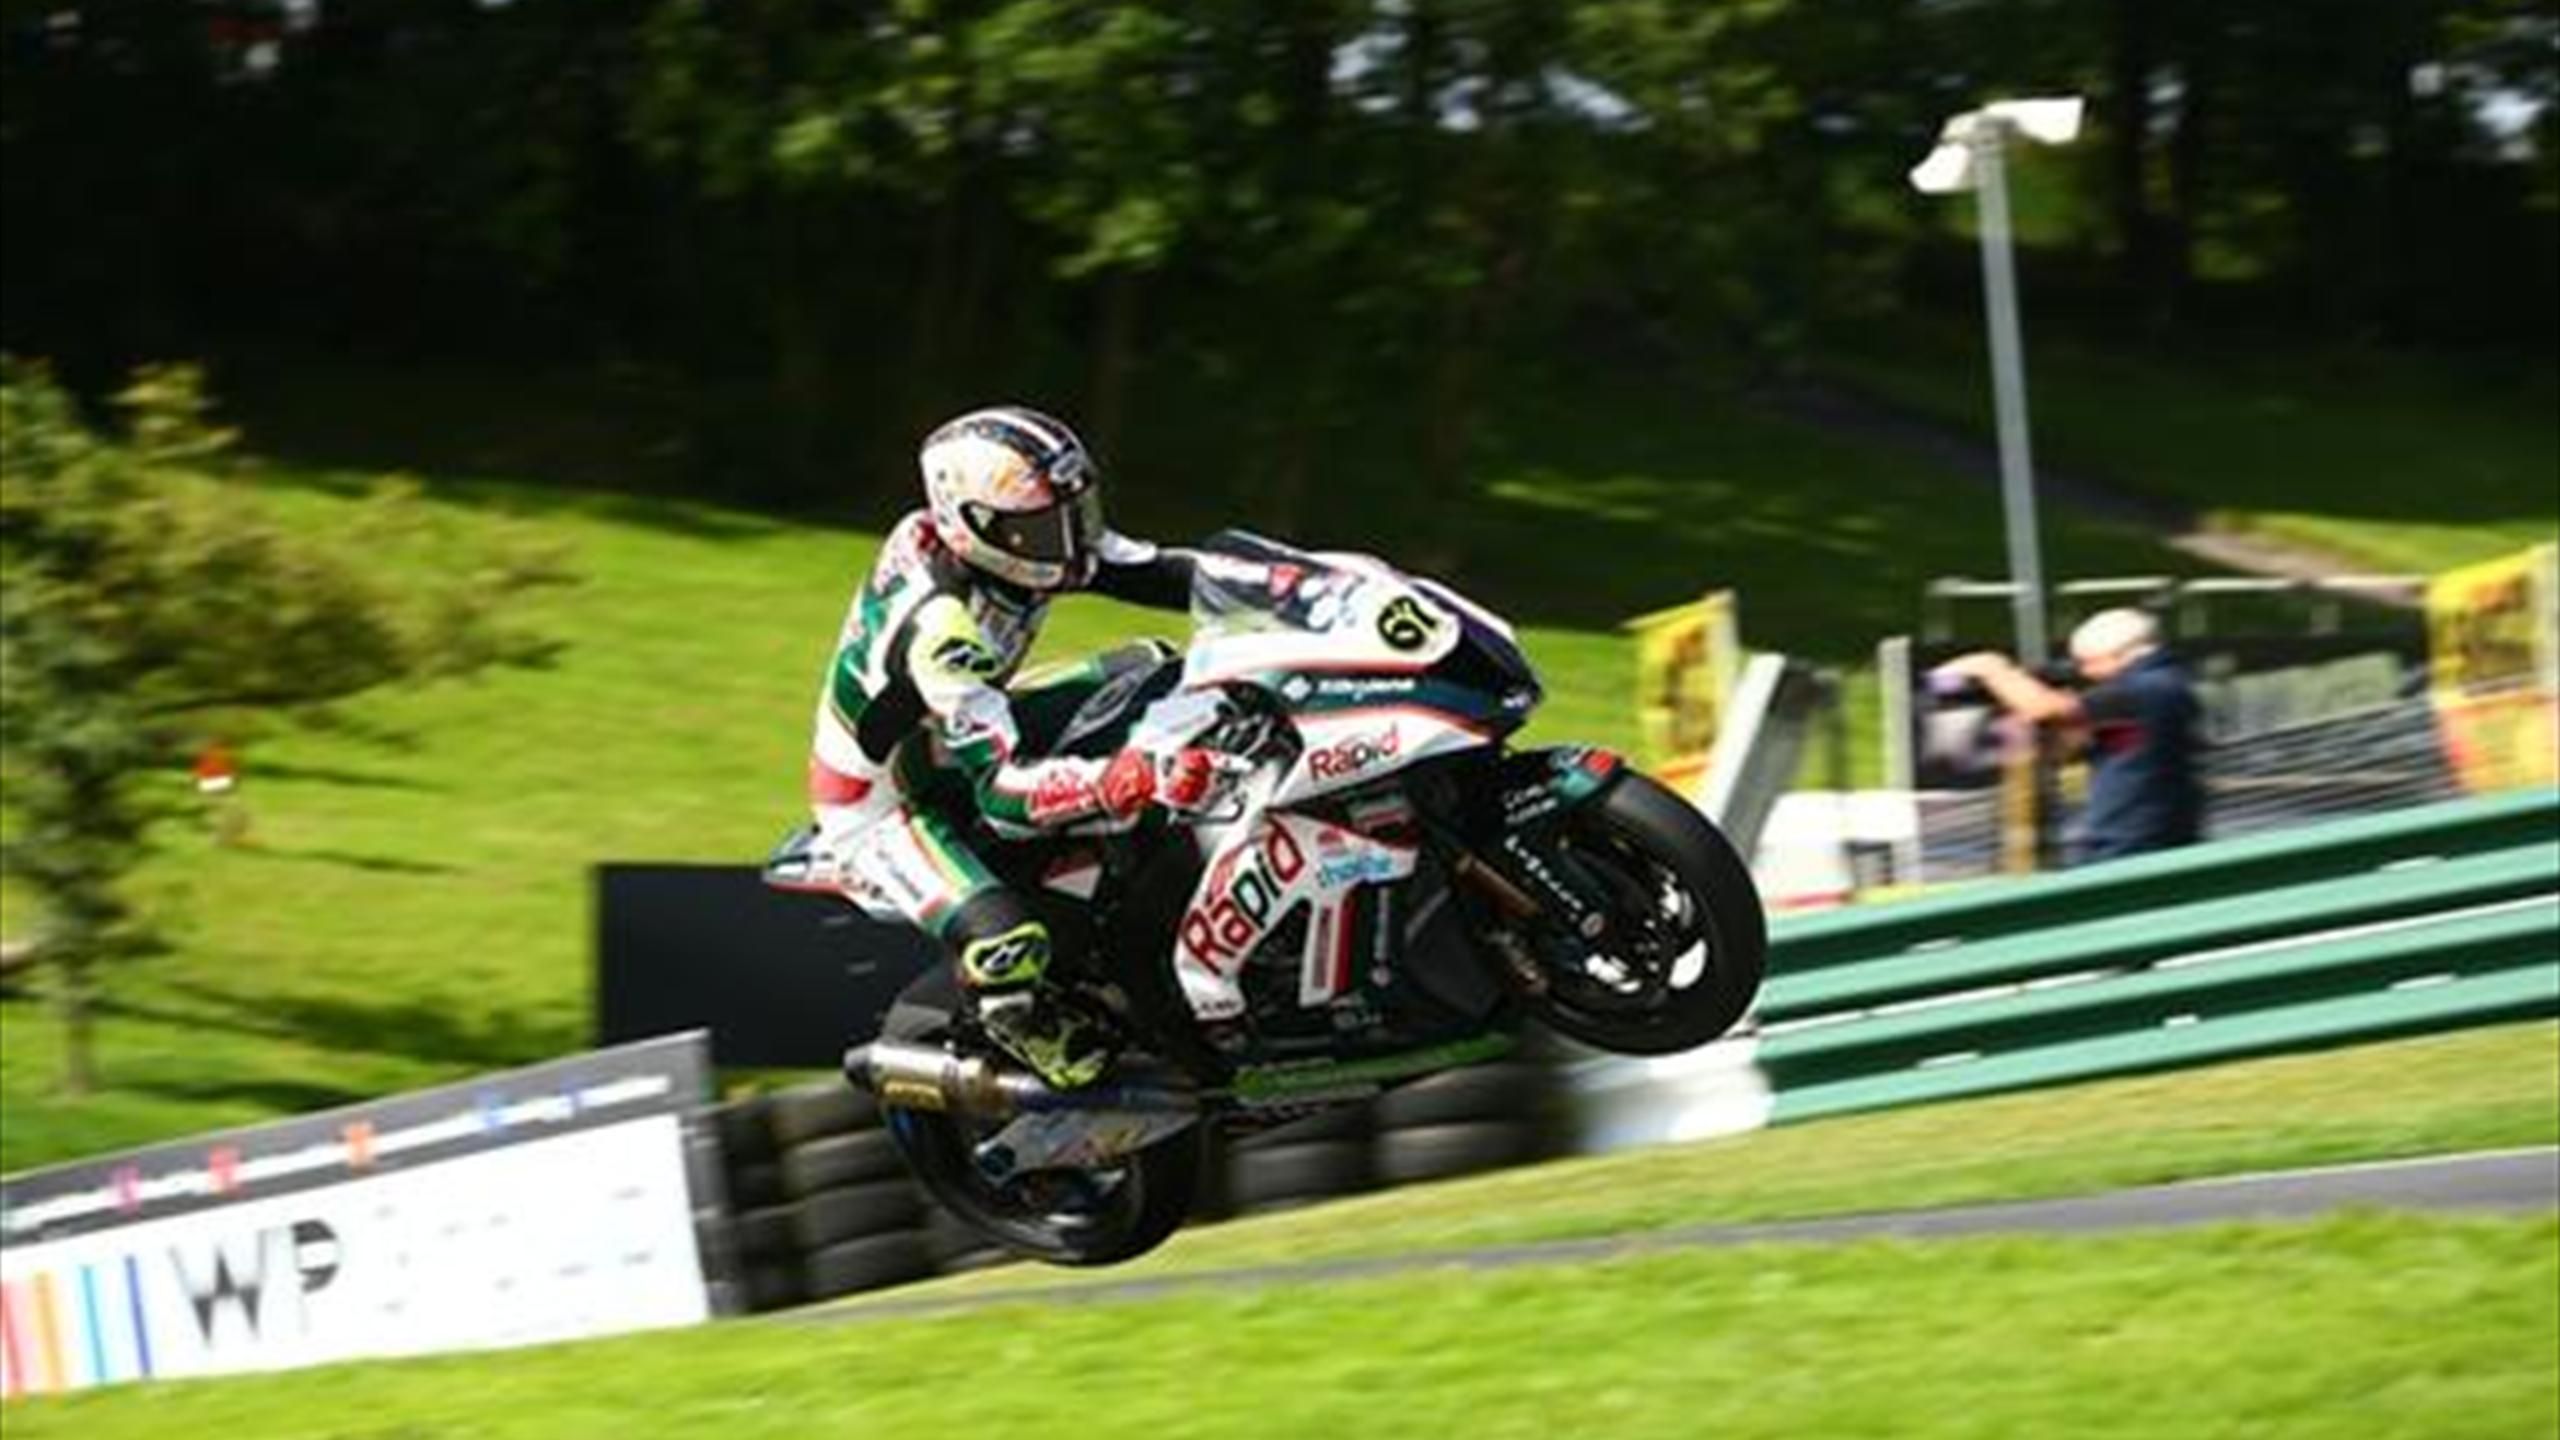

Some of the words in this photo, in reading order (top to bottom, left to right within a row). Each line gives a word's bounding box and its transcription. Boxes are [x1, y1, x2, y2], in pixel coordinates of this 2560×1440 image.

[1377, 594, 1437, 651] 67
[1308, 721, 1401, 780] Rapid
[1182, 816, 1305, 977] Rapid
